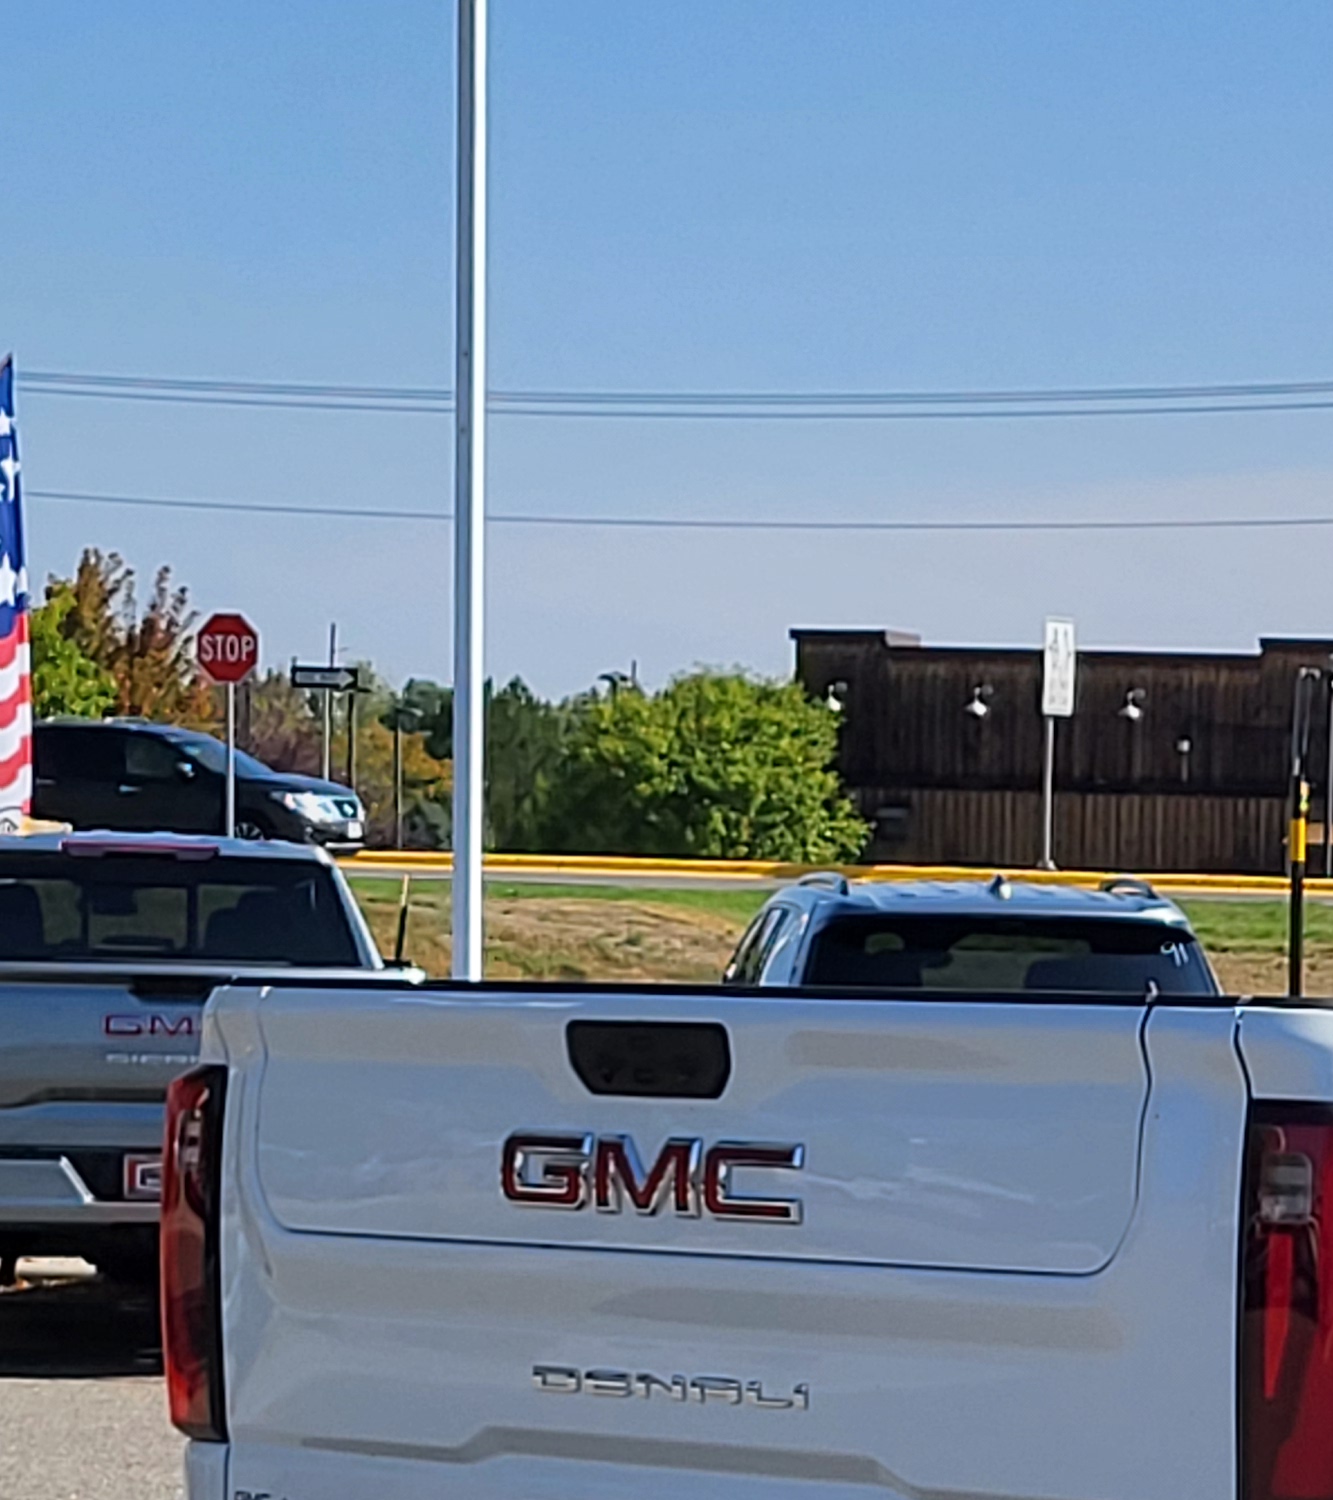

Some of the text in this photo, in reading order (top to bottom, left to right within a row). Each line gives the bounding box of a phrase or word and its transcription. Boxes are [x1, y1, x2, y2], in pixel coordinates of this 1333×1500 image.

[201, 634, 255, 662] STOP
[103, 1014, 203, 1036] GM
[501, 1130, 805, 1223] GMC
[532, 1364, 809, 1411] DENALI
